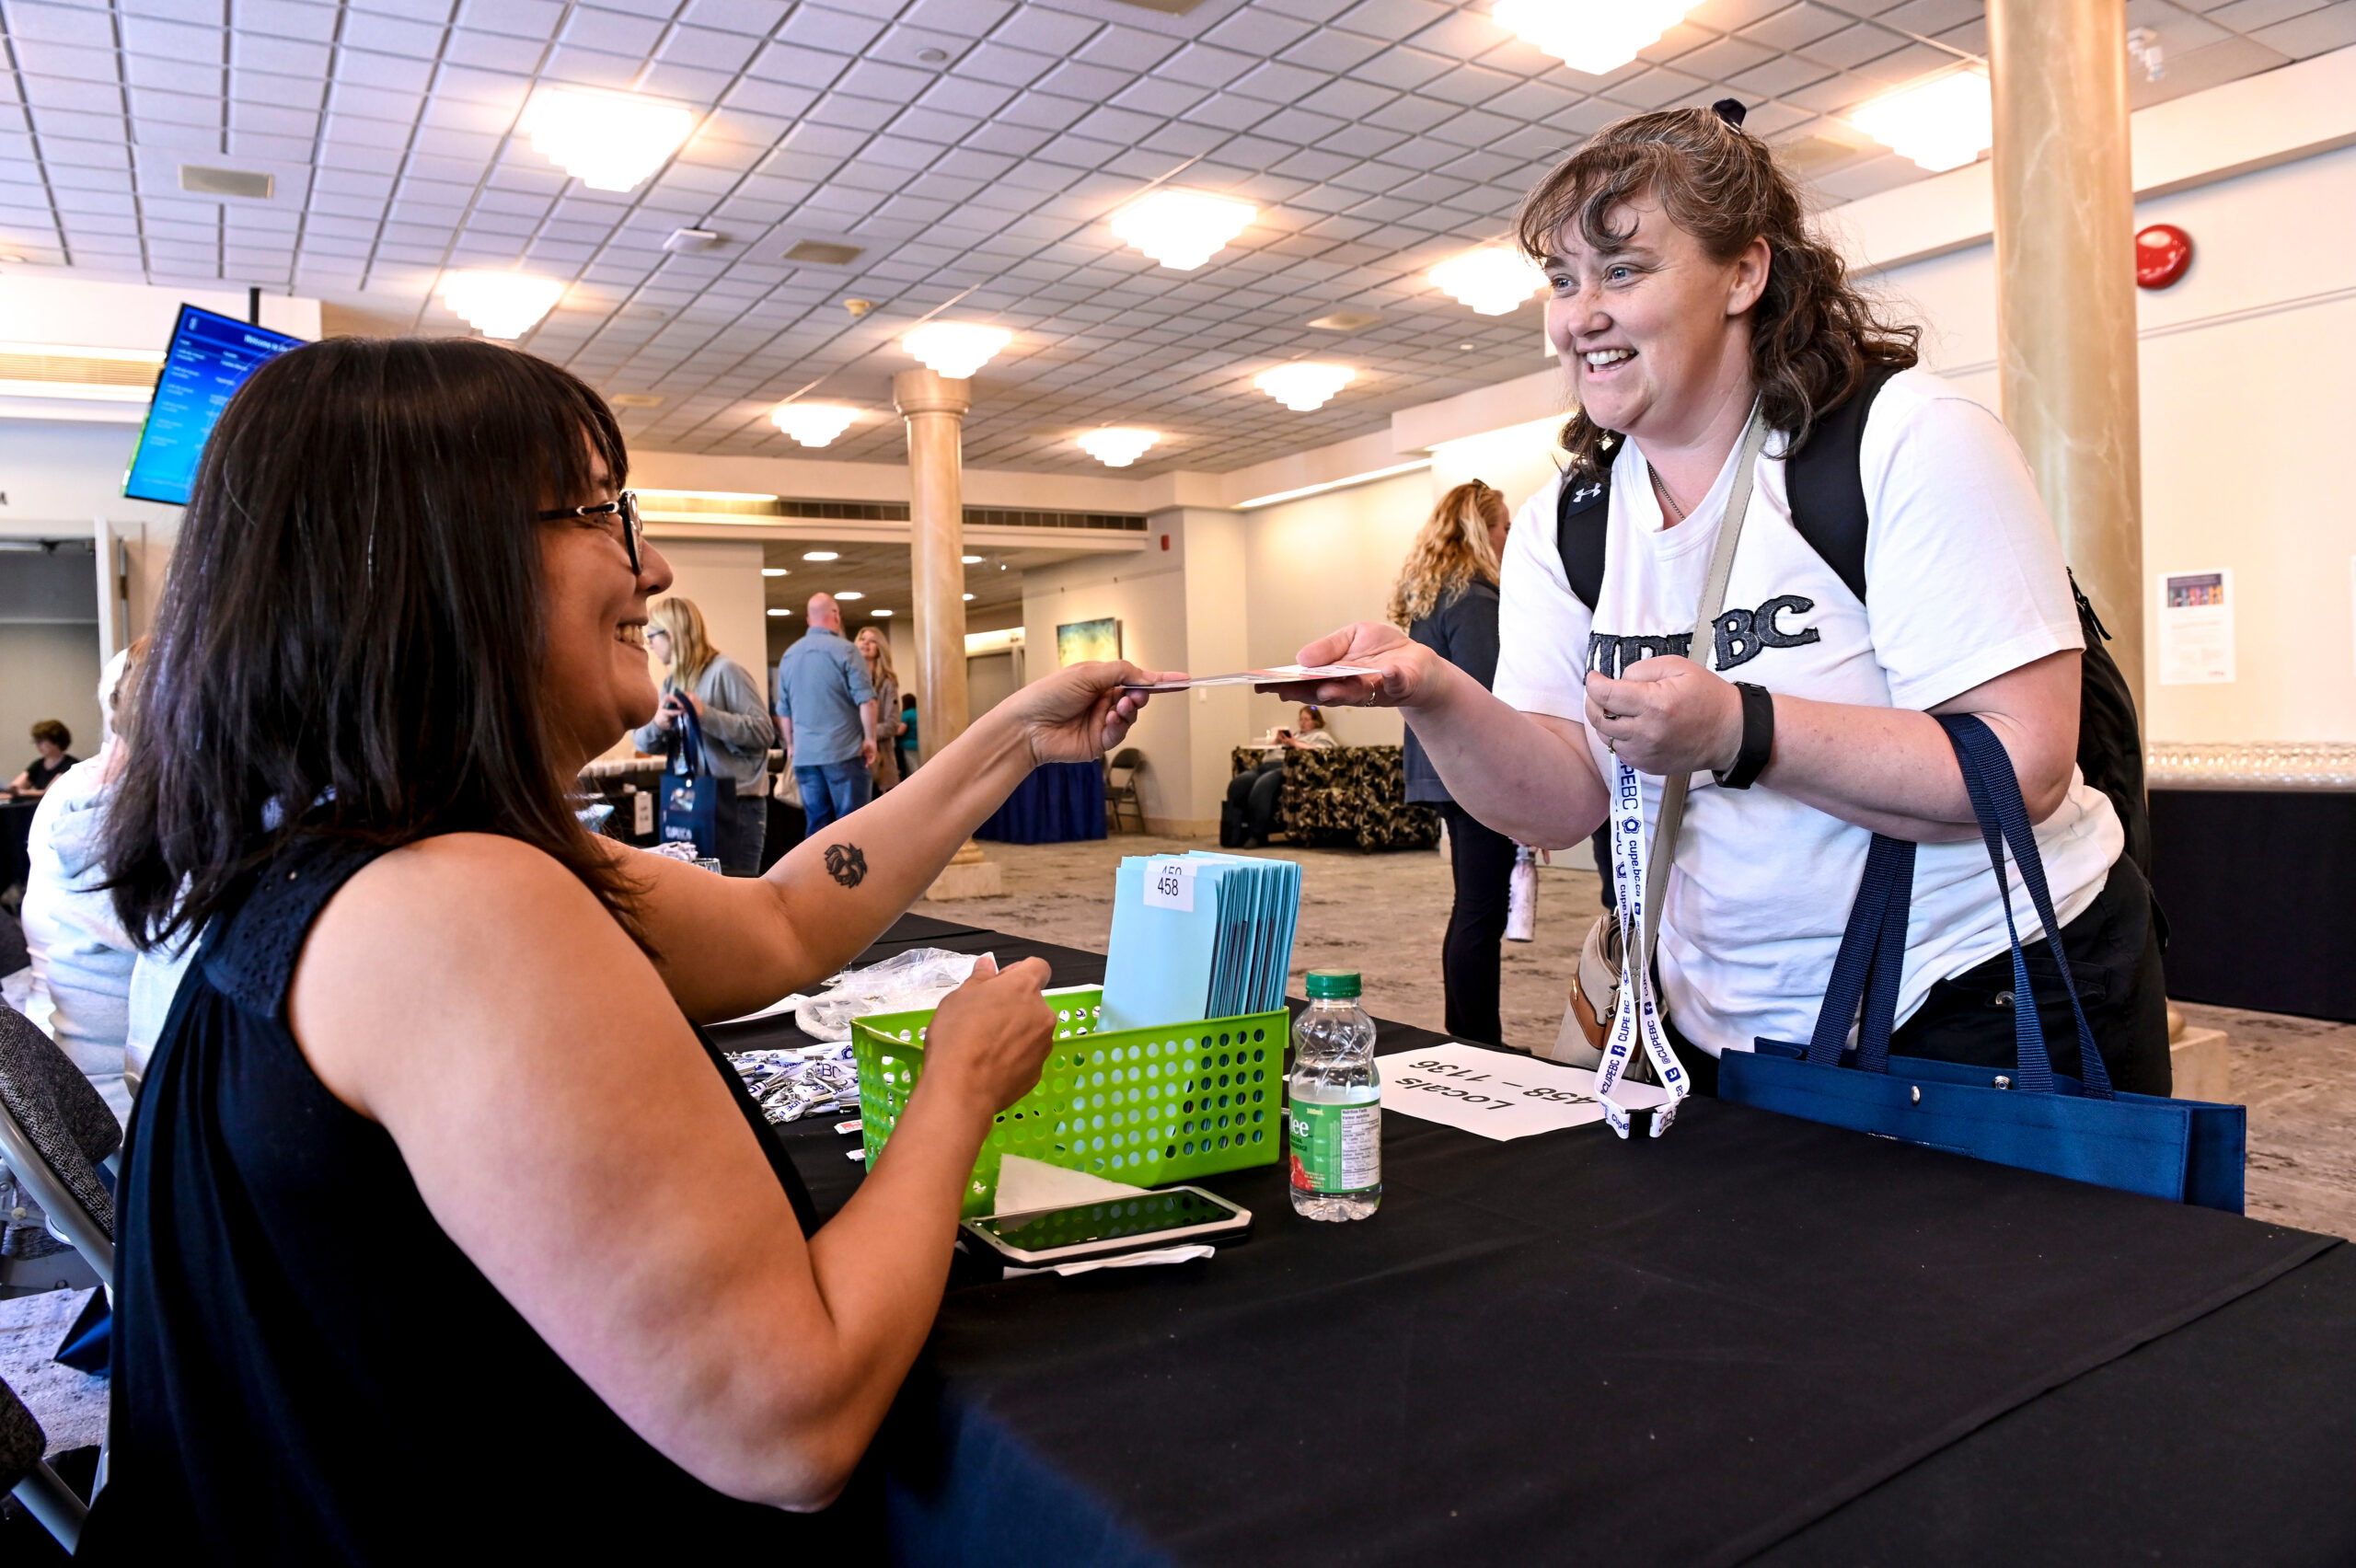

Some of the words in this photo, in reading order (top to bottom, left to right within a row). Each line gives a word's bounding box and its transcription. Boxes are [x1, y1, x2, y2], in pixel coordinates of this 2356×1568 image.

[1712, 594, 1821, 672] BC
[1157, 877, 1179, 896] 458
[1623, 999, 1631, 1014] BC
[1618, 1016, 1631, 1042] CUPE
[1408, 1060, 1492, 1082] 1136
[1395, 1078, 1516, 1110] Locals
[1522, 1088, 1599, 1104] 458
[1289, 1111, 1310, 1137] lee
